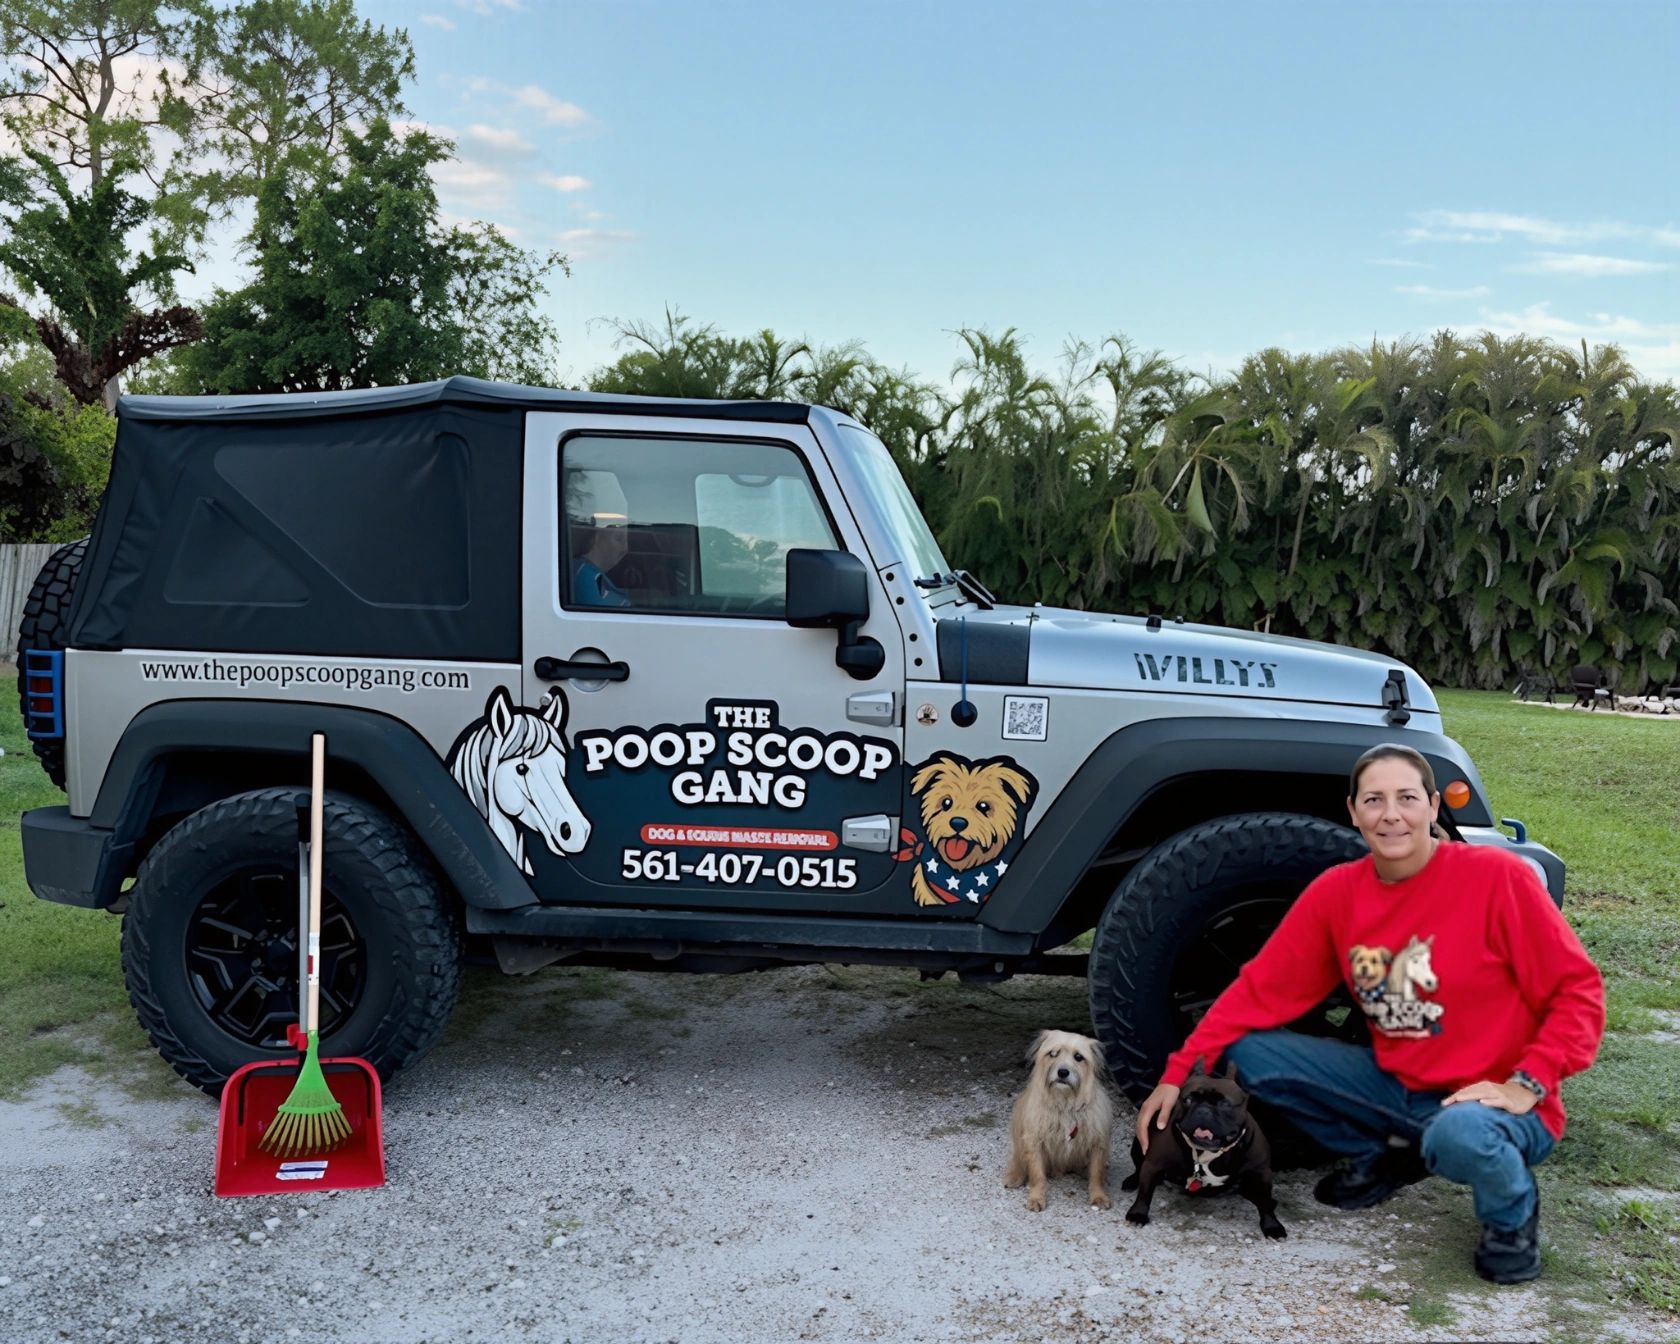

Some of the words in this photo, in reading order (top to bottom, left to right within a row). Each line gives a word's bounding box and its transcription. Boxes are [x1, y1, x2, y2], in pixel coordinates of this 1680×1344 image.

[142, 659, 469, 690] www.thepoopscoopgang.com
[1134, 653, 1277, 688] WILLYS
[714, 706, 770, 728] THE
[582, 731, 716, 772] POOP
[727, 731, 892, 780] SCOOP
[671, 769, 806, 808] GANG
[648, 827, 676, 840] DOG
[622, 850, 857, 888] 561-407-0515
